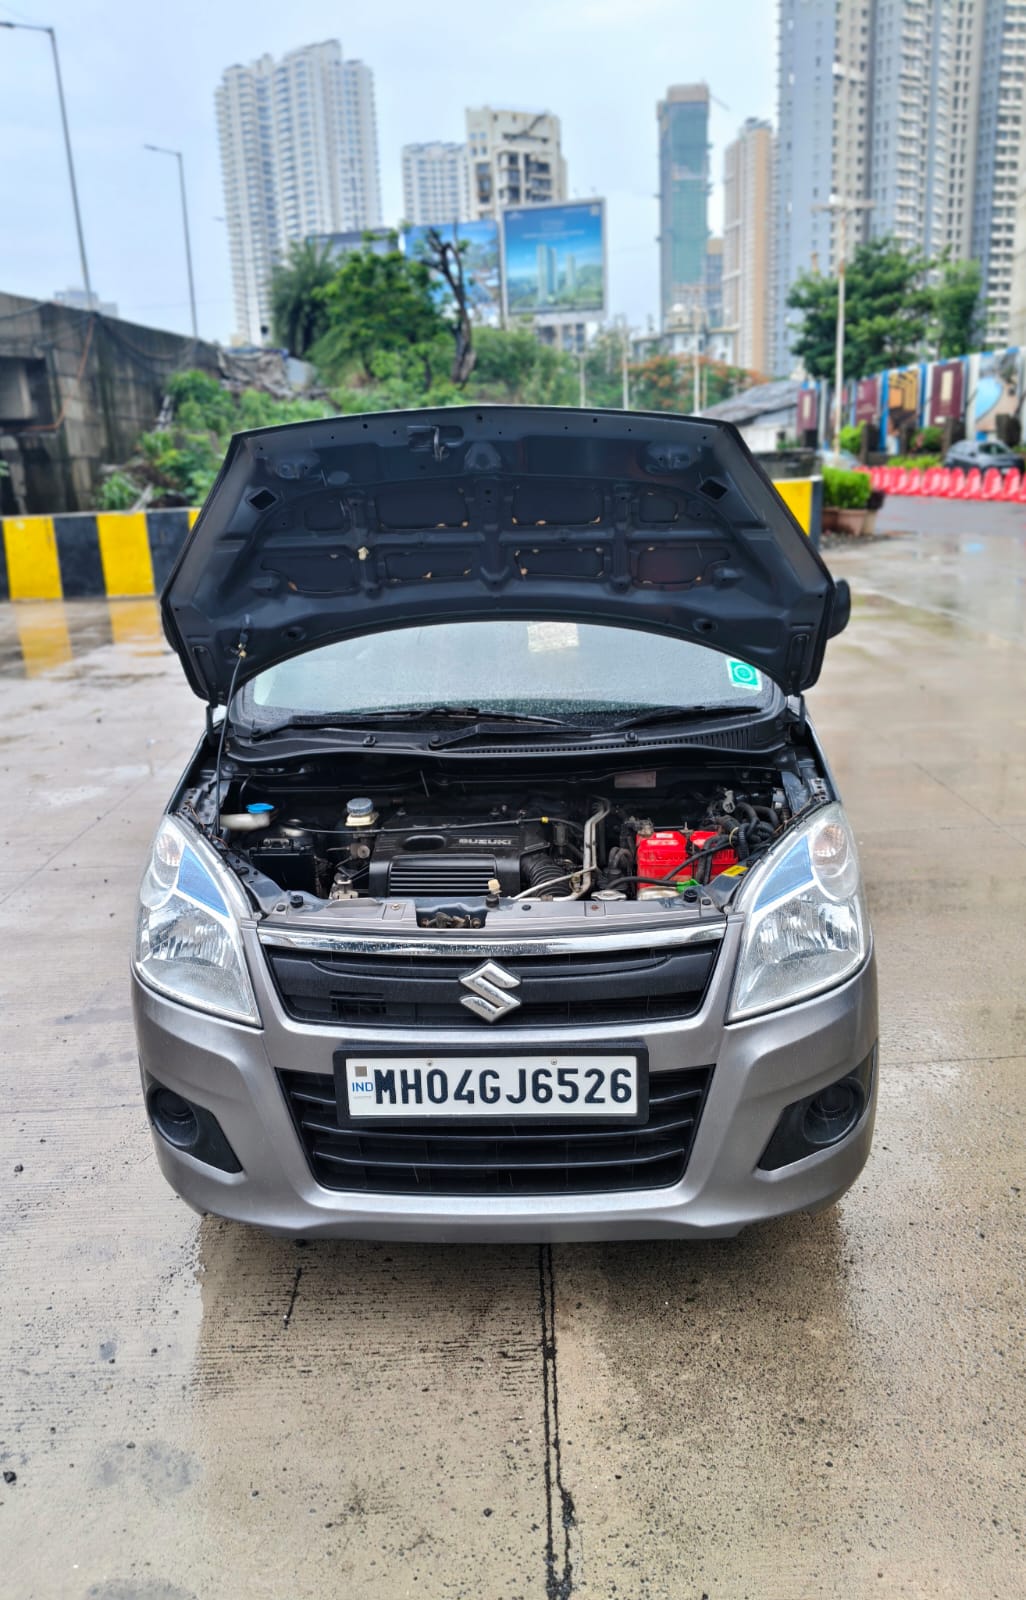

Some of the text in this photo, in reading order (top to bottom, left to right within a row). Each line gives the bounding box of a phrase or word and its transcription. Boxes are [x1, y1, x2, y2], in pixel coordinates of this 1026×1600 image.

[458, 838, 512, 846] SUZUKI
[352, 1081, 373, 1093] IND
[374, 1068, 633, 1105] MH04GJ6526
